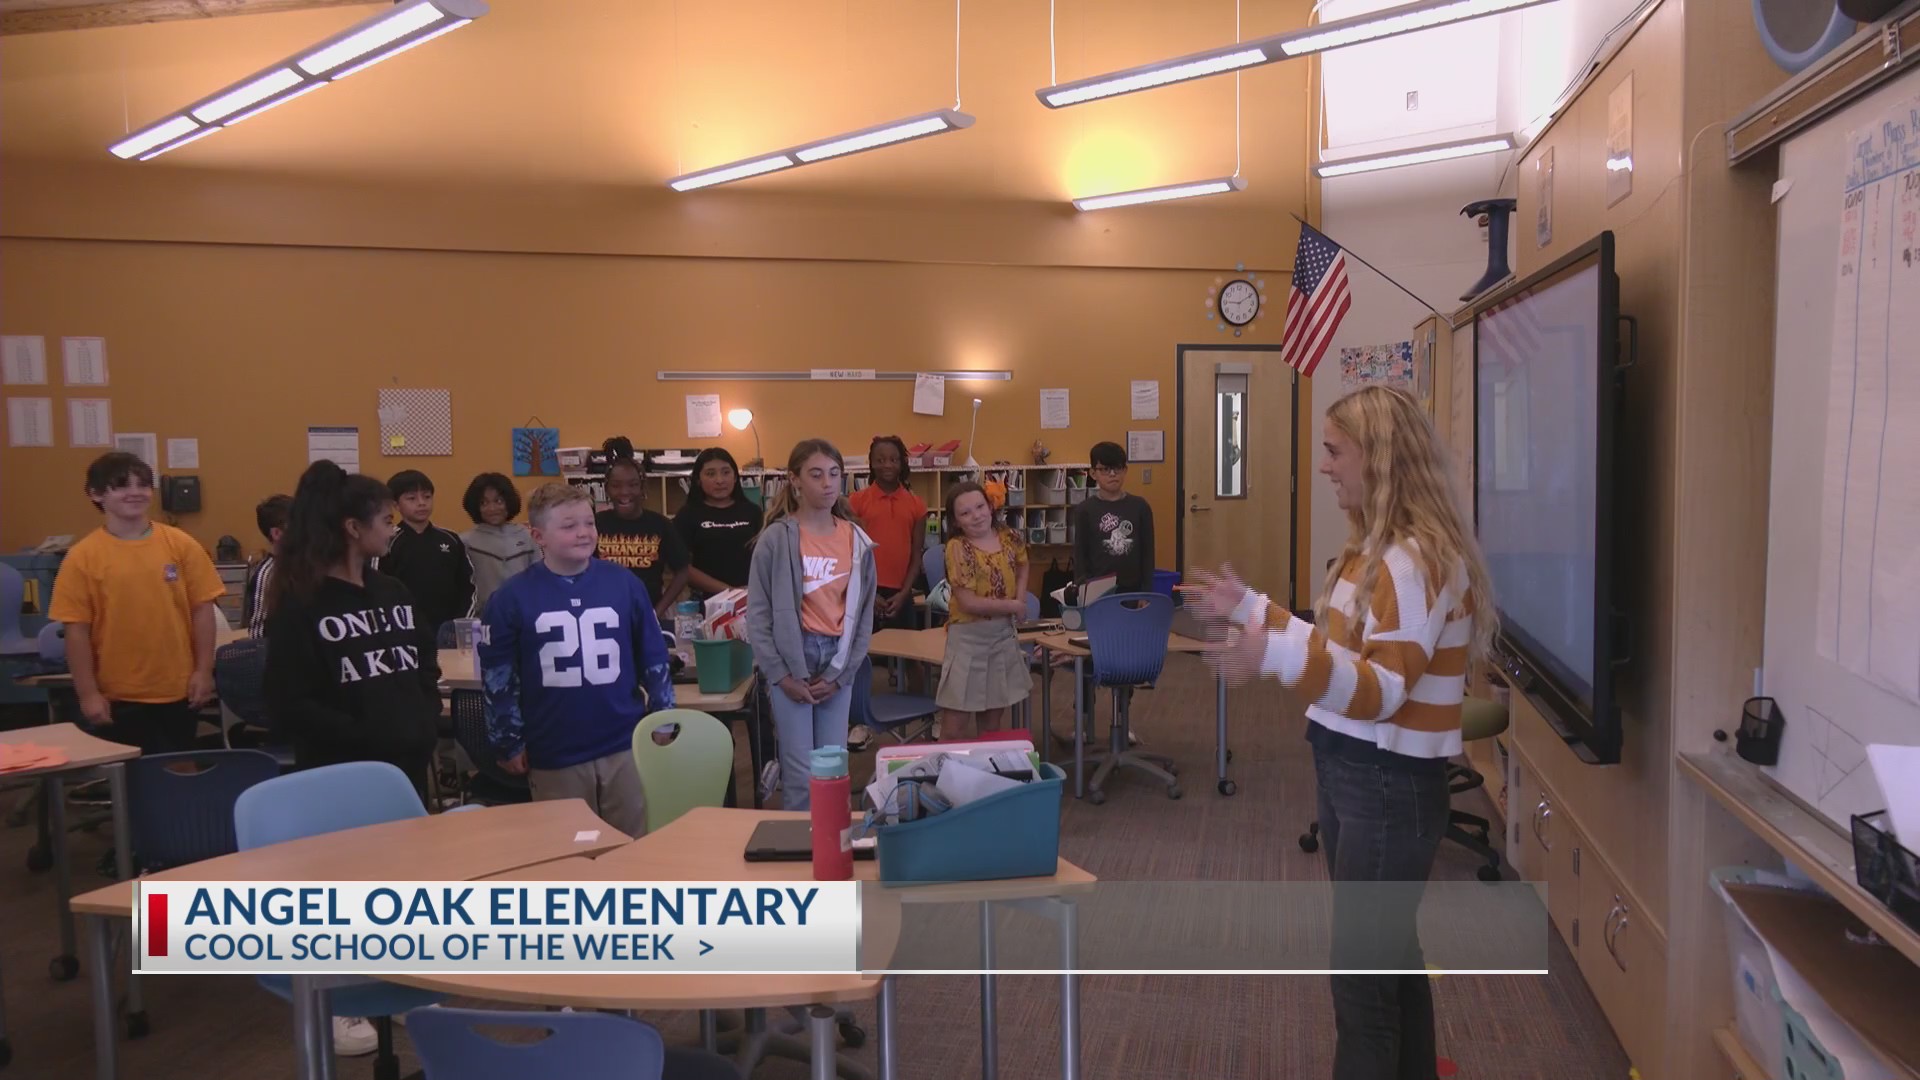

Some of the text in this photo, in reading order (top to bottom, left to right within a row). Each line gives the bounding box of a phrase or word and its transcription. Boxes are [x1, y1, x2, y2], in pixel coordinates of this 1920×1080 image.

[701, 521, 750, 529] Champion
[598, 543, 659, 555] STRANGER
[802, 555, 838, 579] NIKE
[535, 606, 621, 687] 26
[340, 656, 363, 683] A
